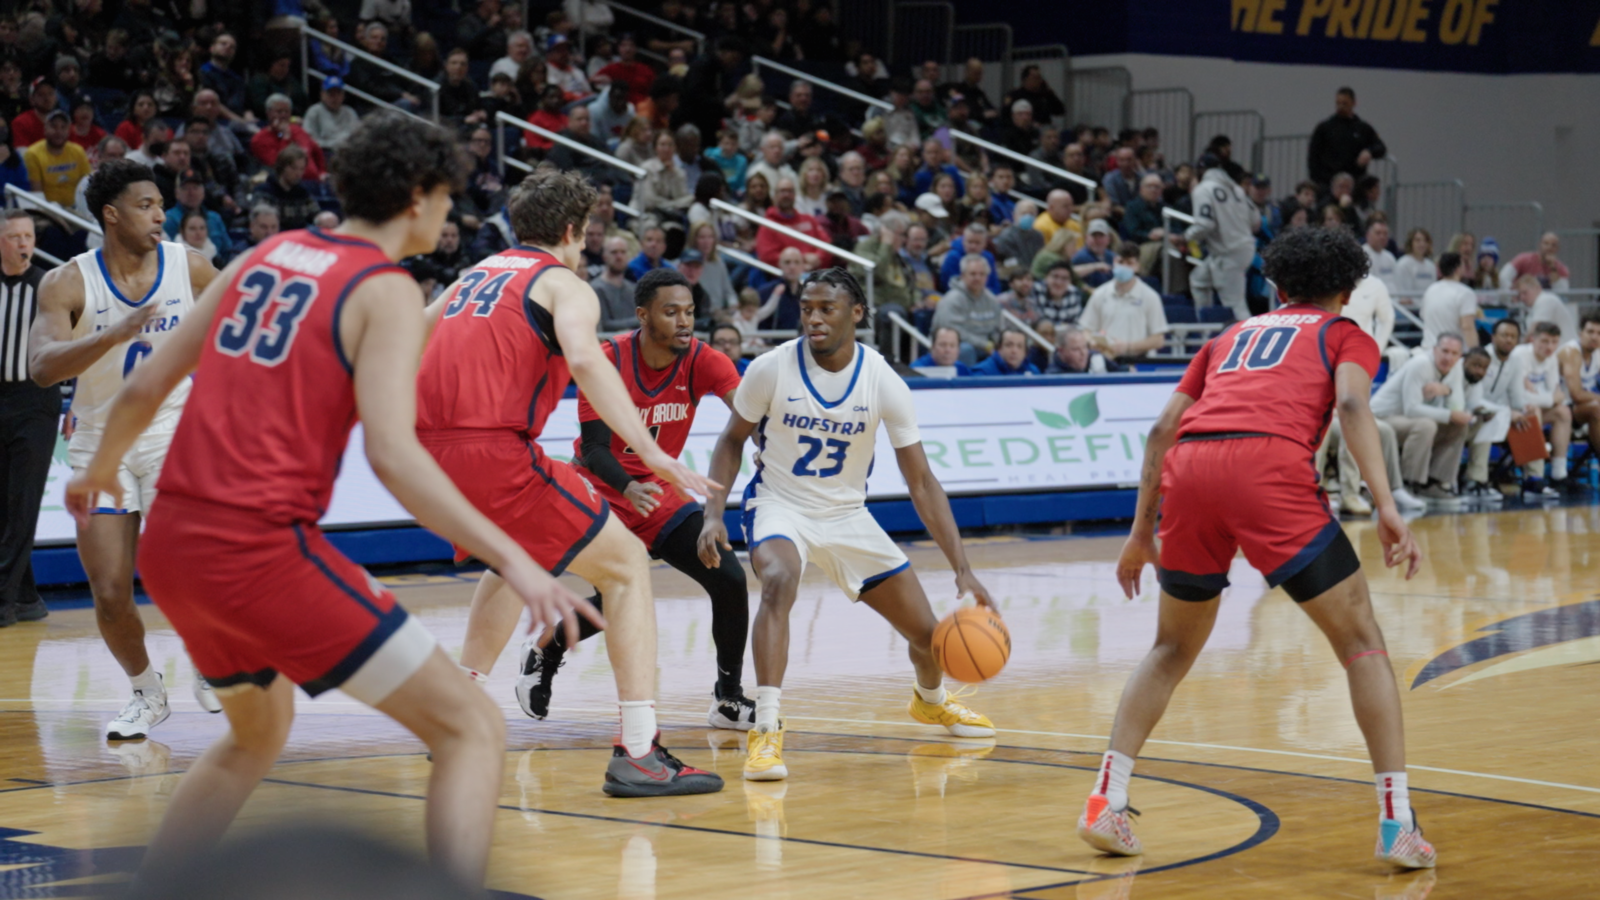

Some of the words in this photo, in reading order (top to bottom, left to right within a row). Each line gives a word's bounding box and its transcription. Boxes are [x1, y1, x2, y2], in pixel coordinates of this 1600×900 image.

[1295, 0, 1430, 42] PRIDE
[1438, 0, 1498, 46] OF
[213, 264, 319, 367] 33
[443, 269, 518, 319] 34
[1240, 313, 1322, 328] ROBERTS
[1216, 325, 1301, 373] 10
[652, 403, 690, 424] BROOK
[782, 412, 867, 435] HOFSTRA
[791, 434, 851, 478] 23
